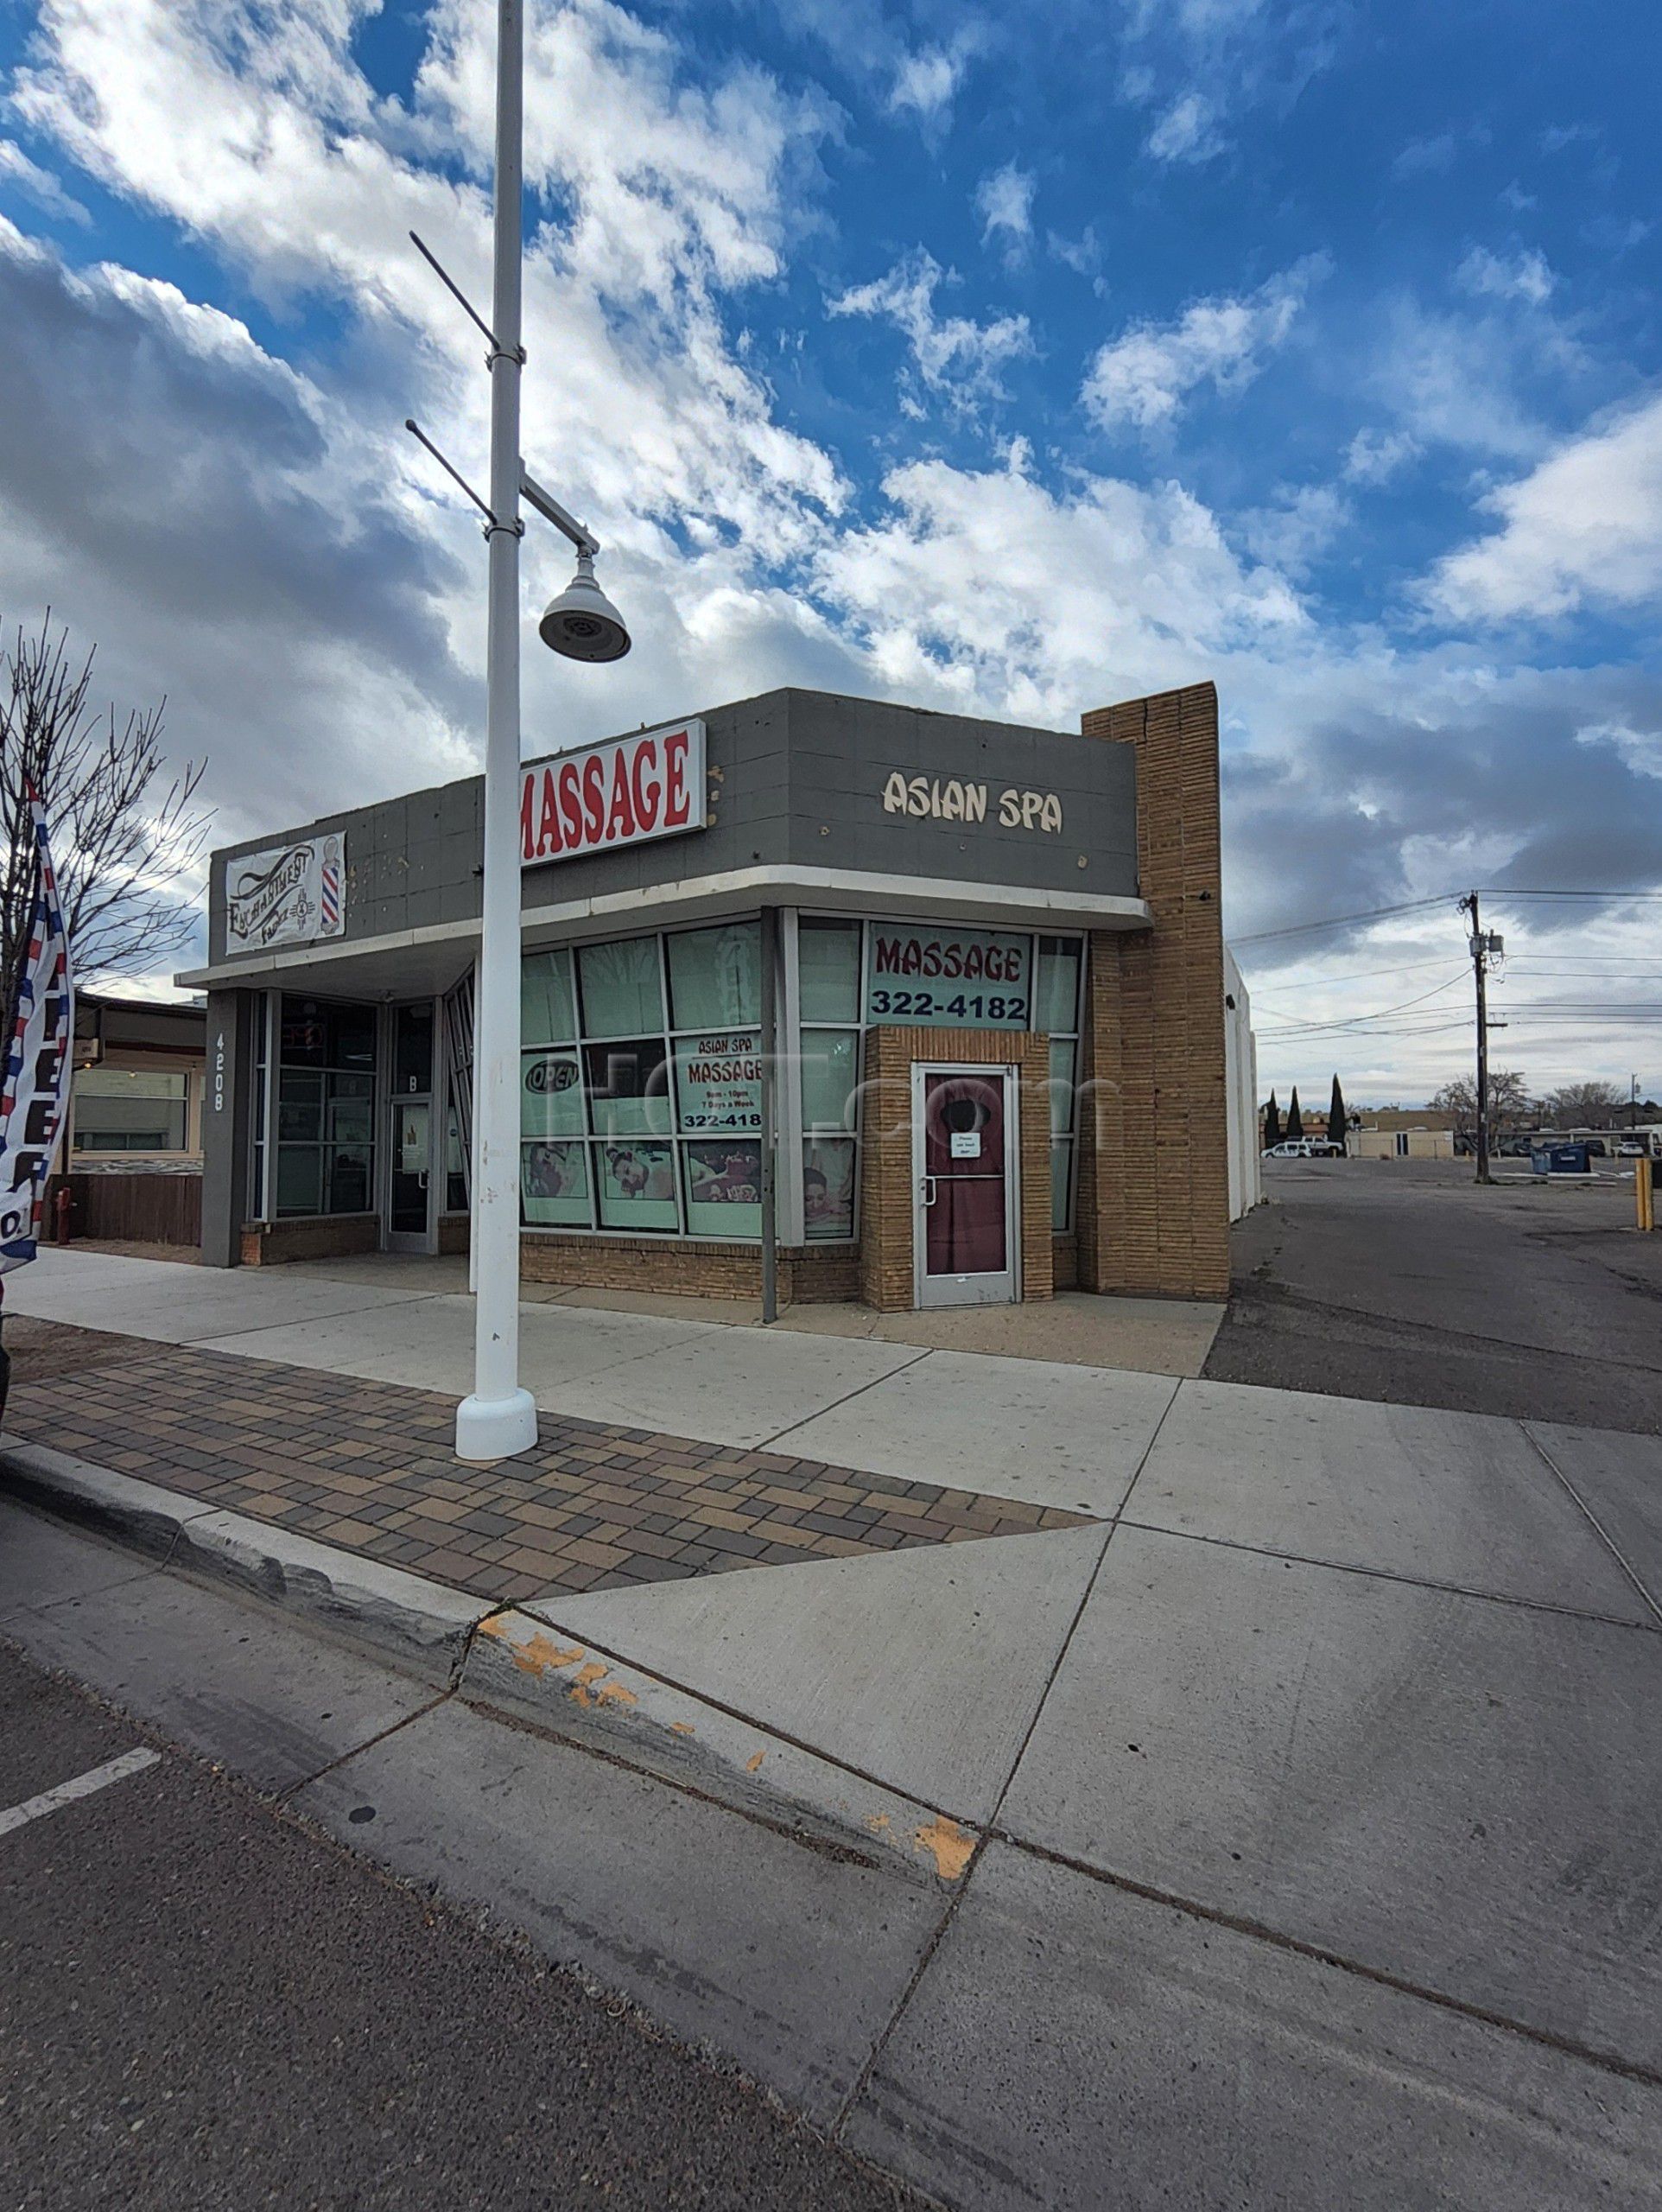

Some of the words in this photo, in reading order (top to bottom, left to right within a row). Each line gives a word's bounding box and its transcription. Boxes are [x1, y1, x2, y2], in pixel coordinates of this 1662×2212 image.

[880, 771, 987, 823] ASIAN
[999, 788, 1064, 836] SPA
[874, 937, 1021, 982] MASSAGE
[871, 989, 1027, 1020] 322-4182
[698, 1039, 728, 1054] ASIAN
[731, 1038, 752, 1052] SPA
[215, 1032, 225, 1111] 4208
[409, 1076, 417, 1091] B
[532, 1065, 578, 1088] OPEN
[688, 1059, 762, 1084] MASSAGE
[683, 1114, 762, 1127] 322-418
